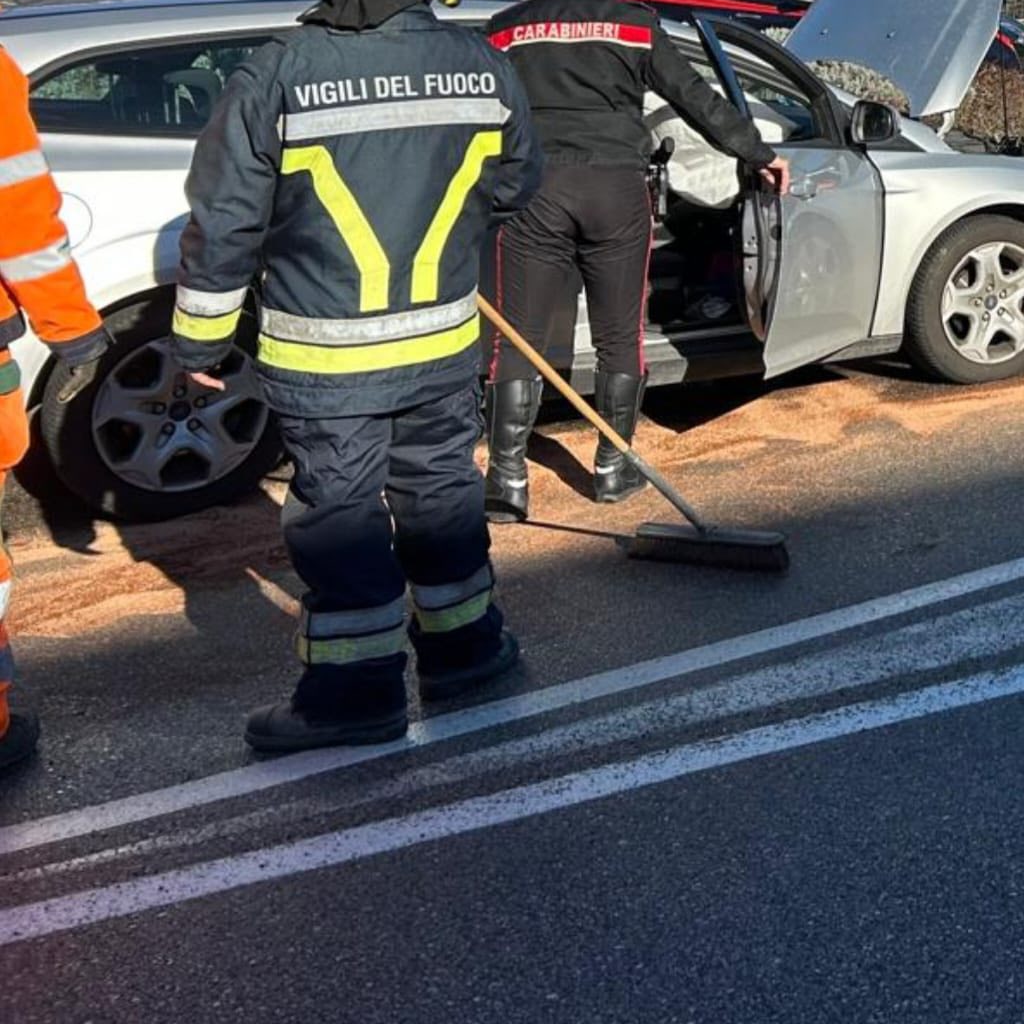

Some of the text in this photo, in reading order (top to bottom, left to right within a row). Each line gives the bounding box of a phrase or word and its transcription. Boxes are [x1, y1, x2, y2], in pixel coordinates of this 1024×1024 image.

[512, 22, 620, 40] CARABINIERI
[294, 72, 496, 107] VIGILI DEL FUOCO
